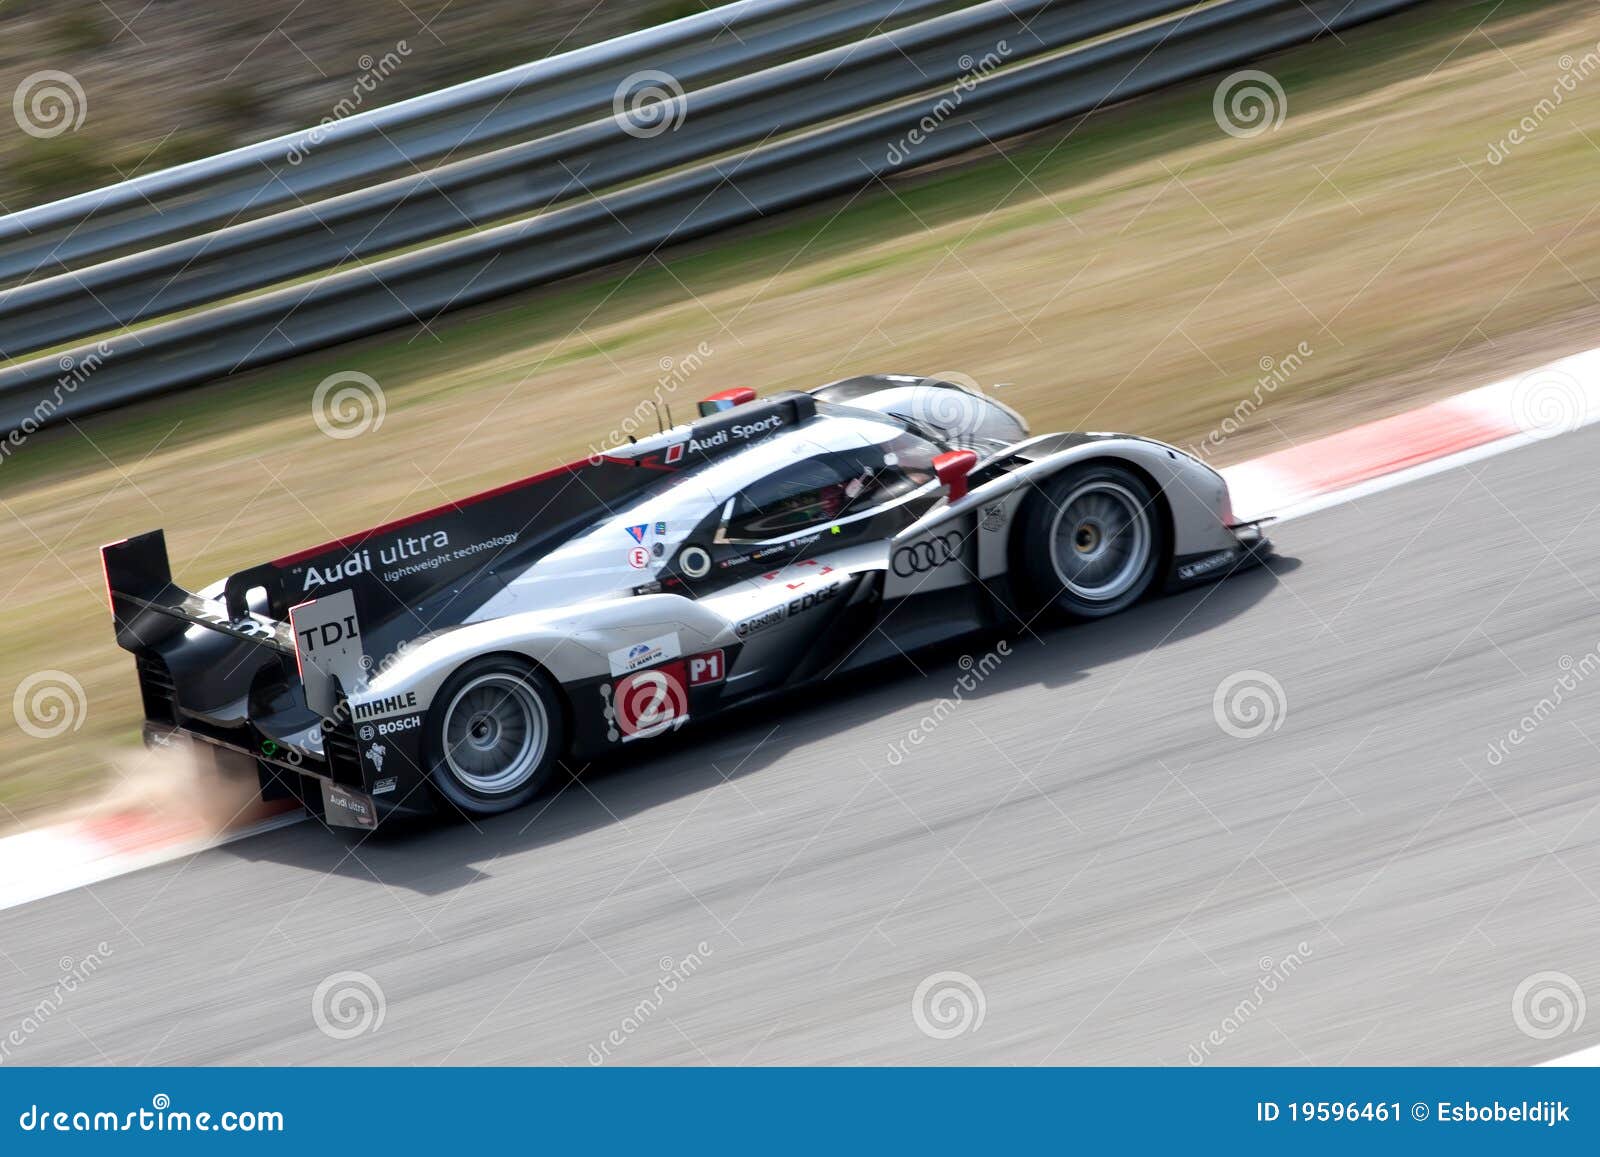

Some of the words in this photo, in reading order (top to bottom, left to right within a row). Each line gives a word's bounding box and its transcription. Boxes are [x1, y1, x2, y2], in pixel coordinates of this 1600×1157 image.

[688, 430, 728, 453] Audi
[731, 415, 783, 439] Sport
[303, 549, 372, 591] Audi
[380, 530, 449, 565] ultra
[384, 553, 452, 582] lightweight
[453, 532, 519, 559] technology
[635, 551, 643, 564] E
[786, 582, 841, 618] EDGE
[299, 615, 358, 652] TDI
[690, 655, 719, 682] P1
[354, 691, 417, 719] MAHLE
[631, 671, 675, 730] 2
[378, 715, 421, 736] BOSCH
